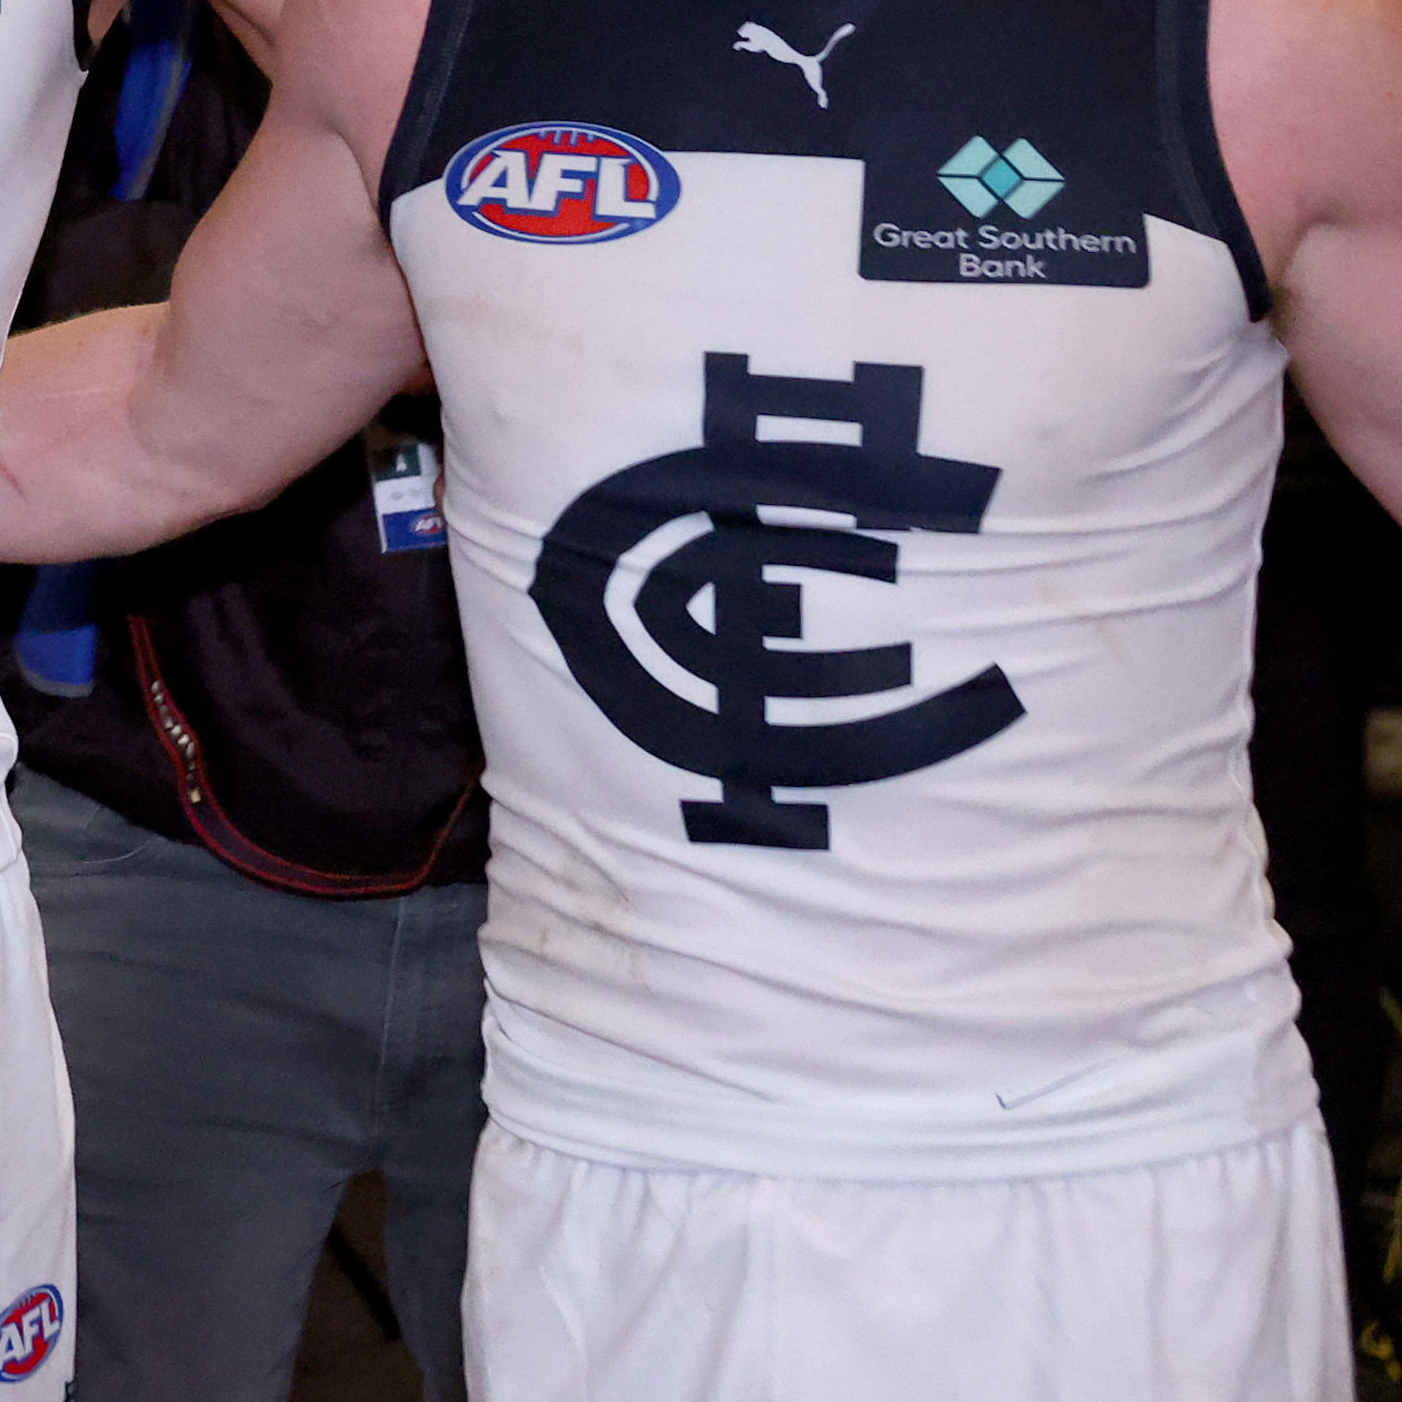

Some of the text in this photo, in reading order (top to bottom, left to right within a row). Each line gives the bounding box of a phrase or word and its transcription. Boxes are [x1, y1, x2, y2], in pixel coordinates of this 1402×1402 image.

[456, 149, 657, 220] AFL
[872, 223, 1137, 255] Great Southern
[959, 252, 1047, 280] Bank
